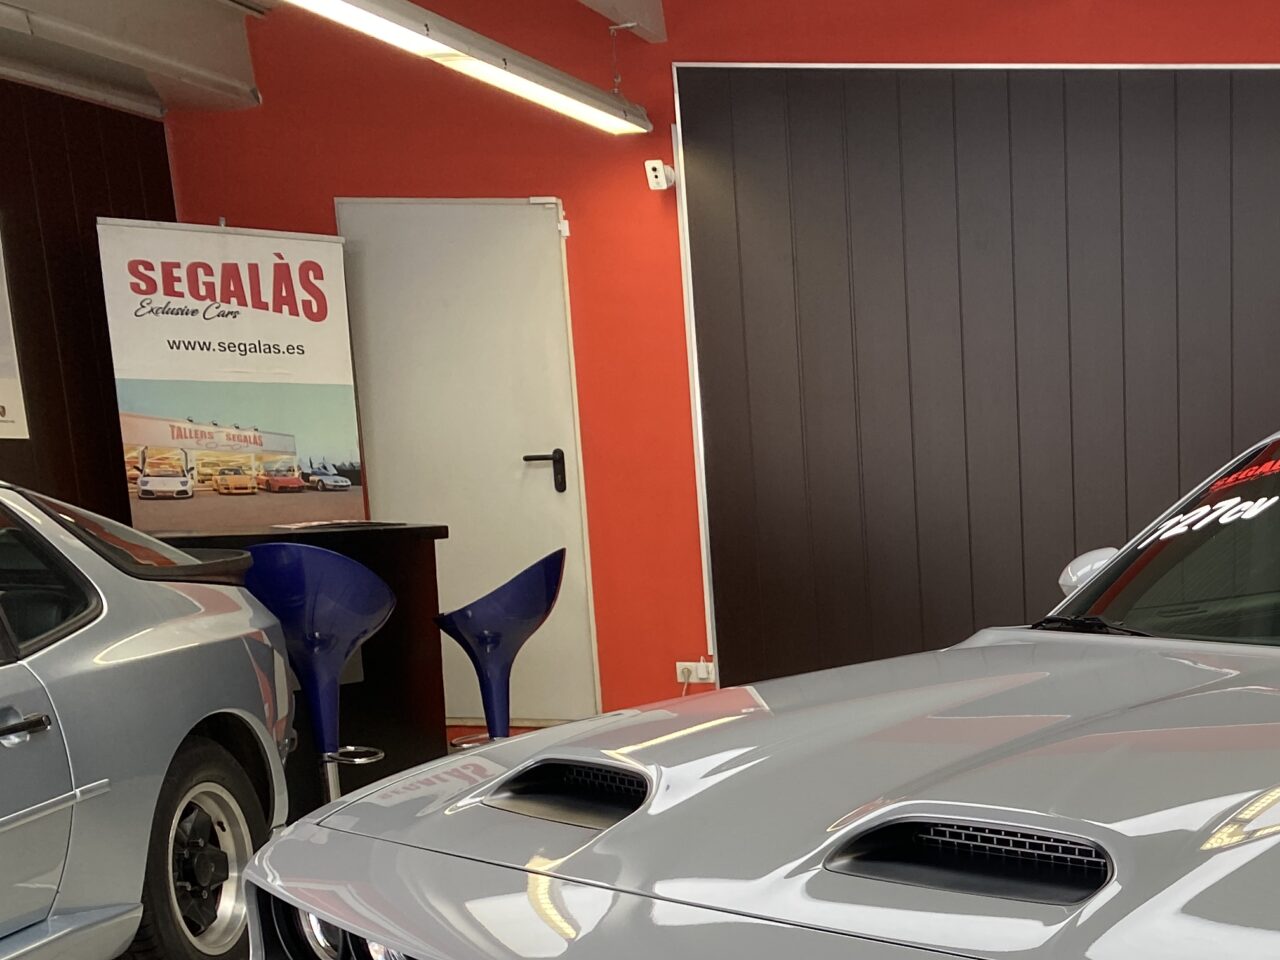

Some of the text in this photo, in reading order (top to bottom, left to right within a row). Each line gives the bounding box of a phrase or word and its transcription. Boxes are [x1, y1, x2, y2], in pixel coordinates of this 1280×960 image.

[127, 252, 328, 323] SEGALÀS
[134, 298, 240, 320] Exclusive Cars
[167, 339, 305, 356] www.segalas.es
